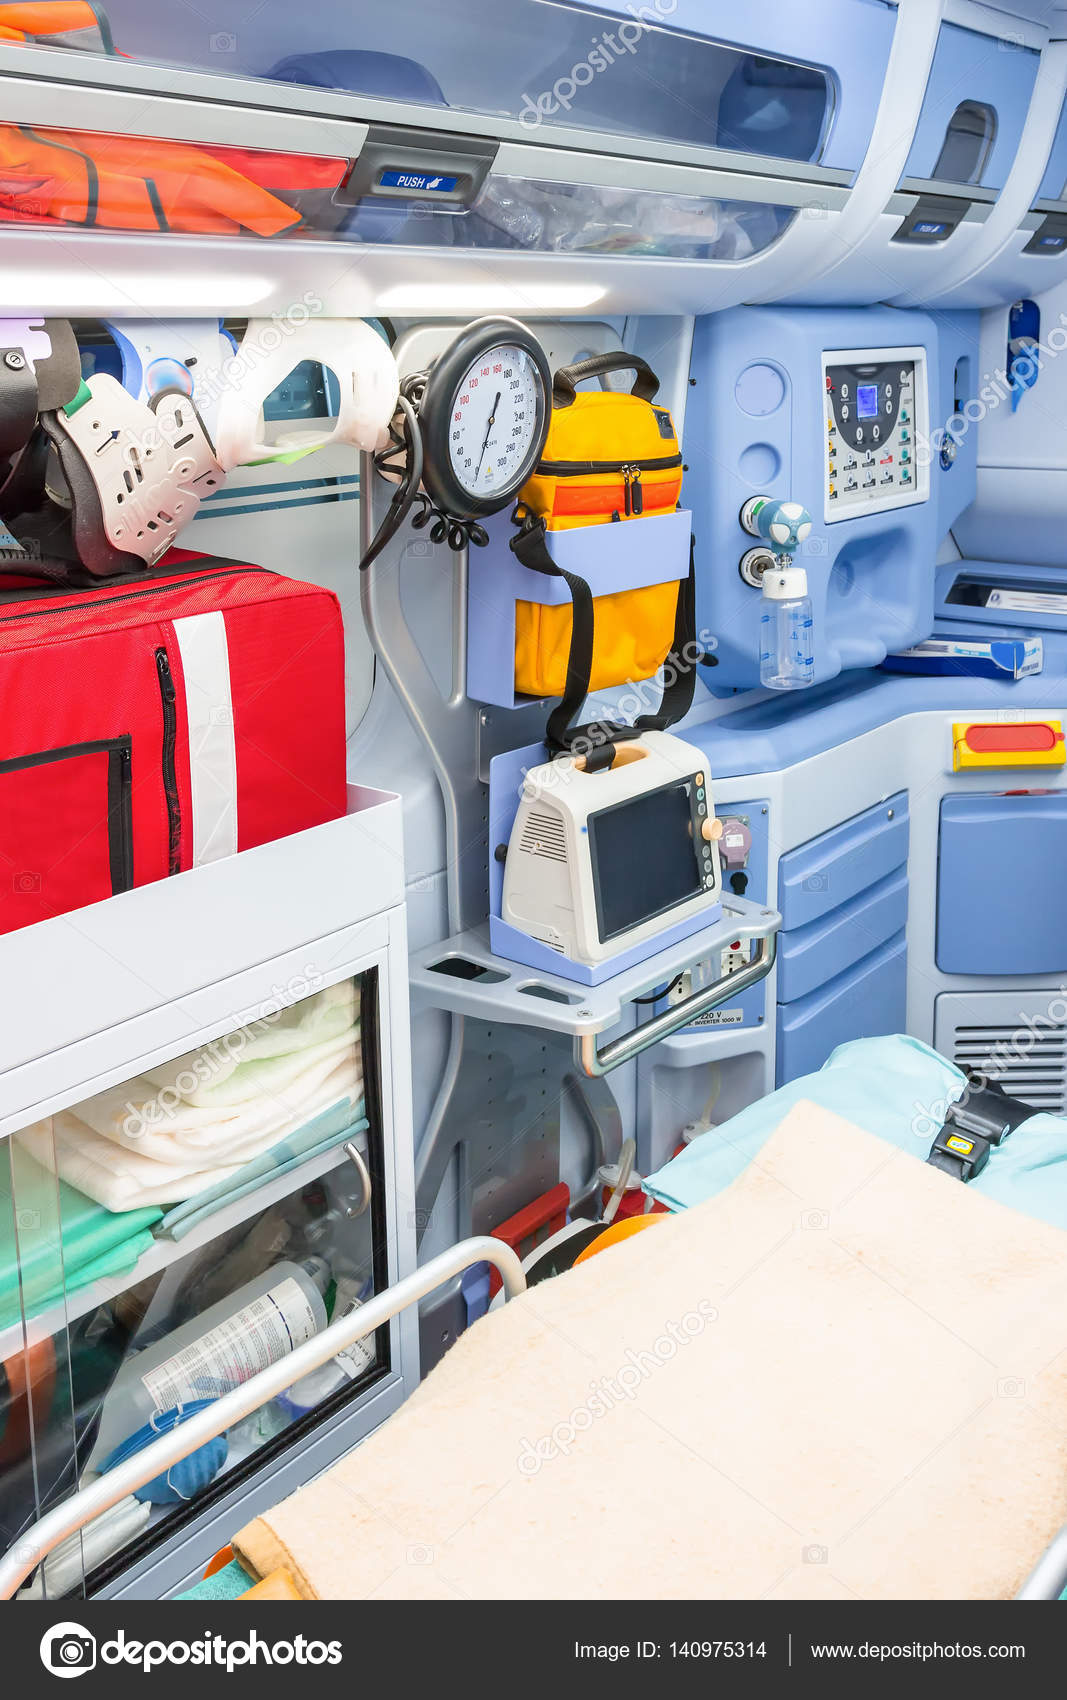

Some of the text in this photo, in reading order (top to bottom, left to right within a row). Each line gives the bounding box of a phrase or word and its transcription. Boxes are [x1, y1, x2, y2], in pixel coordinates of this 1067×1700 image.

[396, 175, 426, 188] PUSH
[480, 367, 490, 377] 140
[492, 364, 502, 374] 160
[503, 368, 513, 379] 180
[468, 377, 479, 388] 120
[509, 380, 519, 390] 200
[460, 394, 470, 405] 100
[514, 393, 524, 404] 220
[514, 412, 525, 422] 240
[452, 430, 460, 440] 60
[457, 446, 464, 456] 40
[464, 457, 472, 468] 20
[497, 456, 507, 467] 300
[701, 1012, 714, 1020] 220
